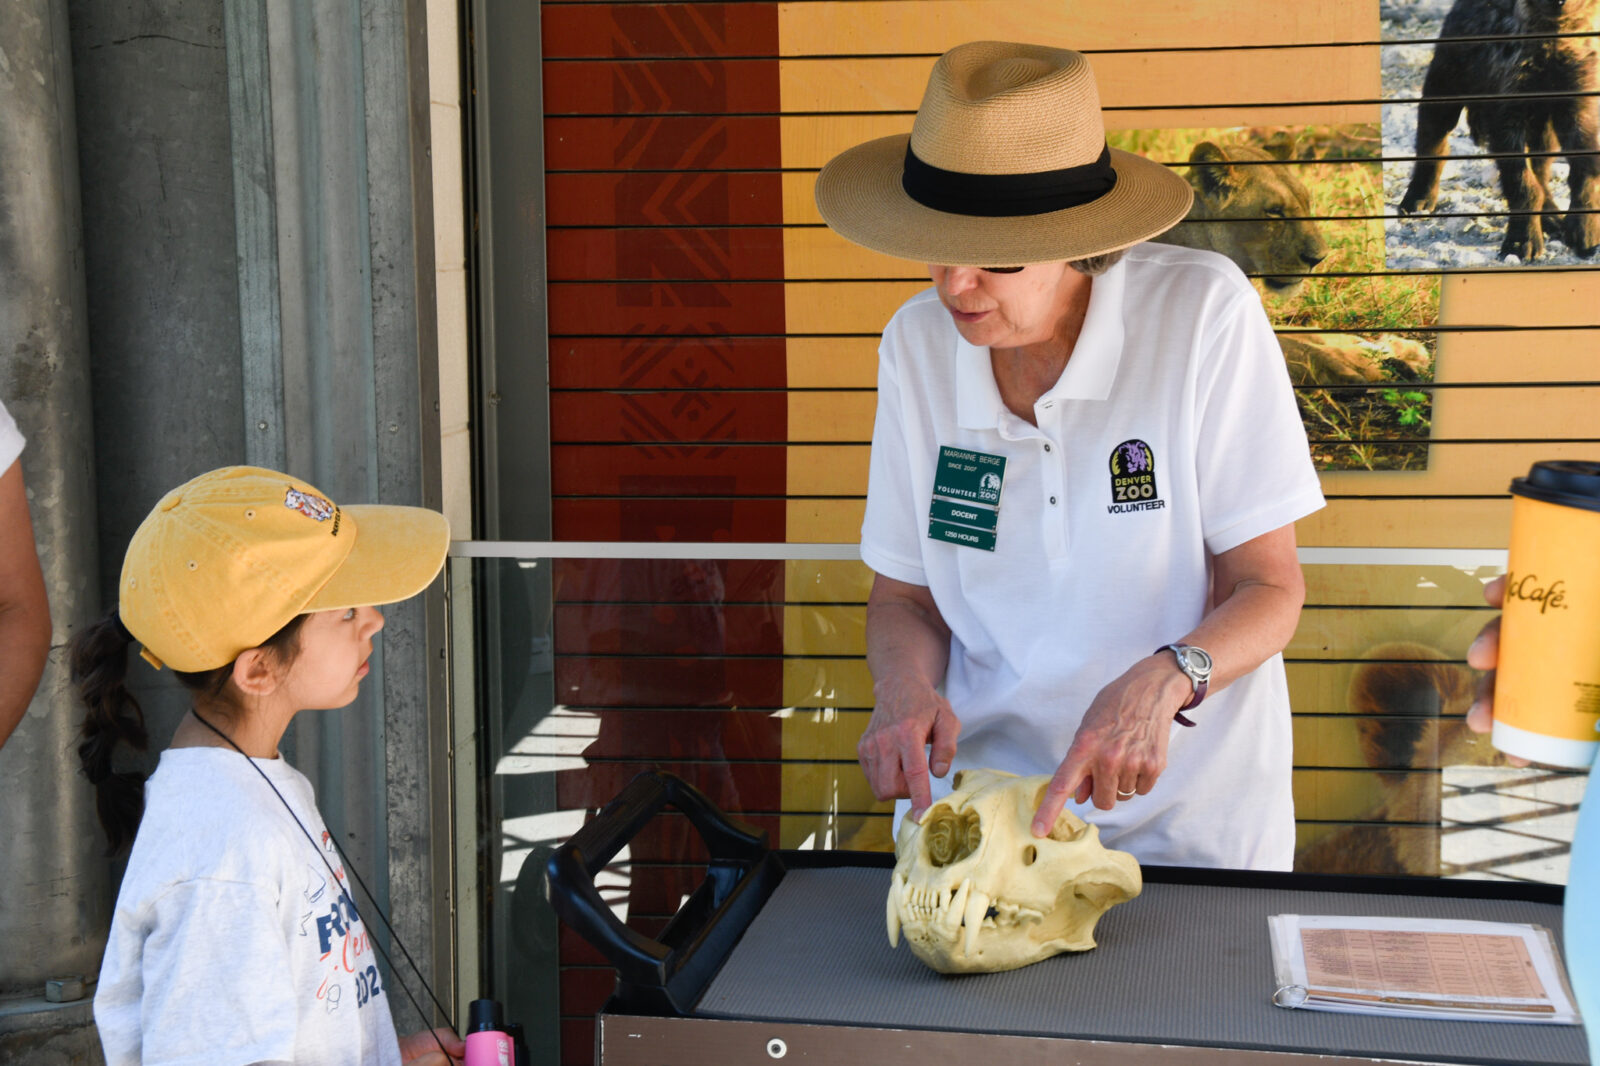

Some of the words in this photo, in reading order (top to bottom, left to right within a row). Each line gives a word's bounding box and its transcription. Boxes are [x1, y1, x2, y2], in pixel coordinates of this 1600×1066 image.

[944, 450, 976, 462] MARIANNE
[1115, 475, 1152, 486] DENVER
[938, 486, 977, 498] VOLUNTEER
[980, 491, 997, 500] ZOO
[1116, 484, 1153, 500] ZOO
[1107, 500, 1165, 514] VOLUNTEER
[951, 509, 978, 520] DOCENT
[958, 534, 979, 542] HOURS
